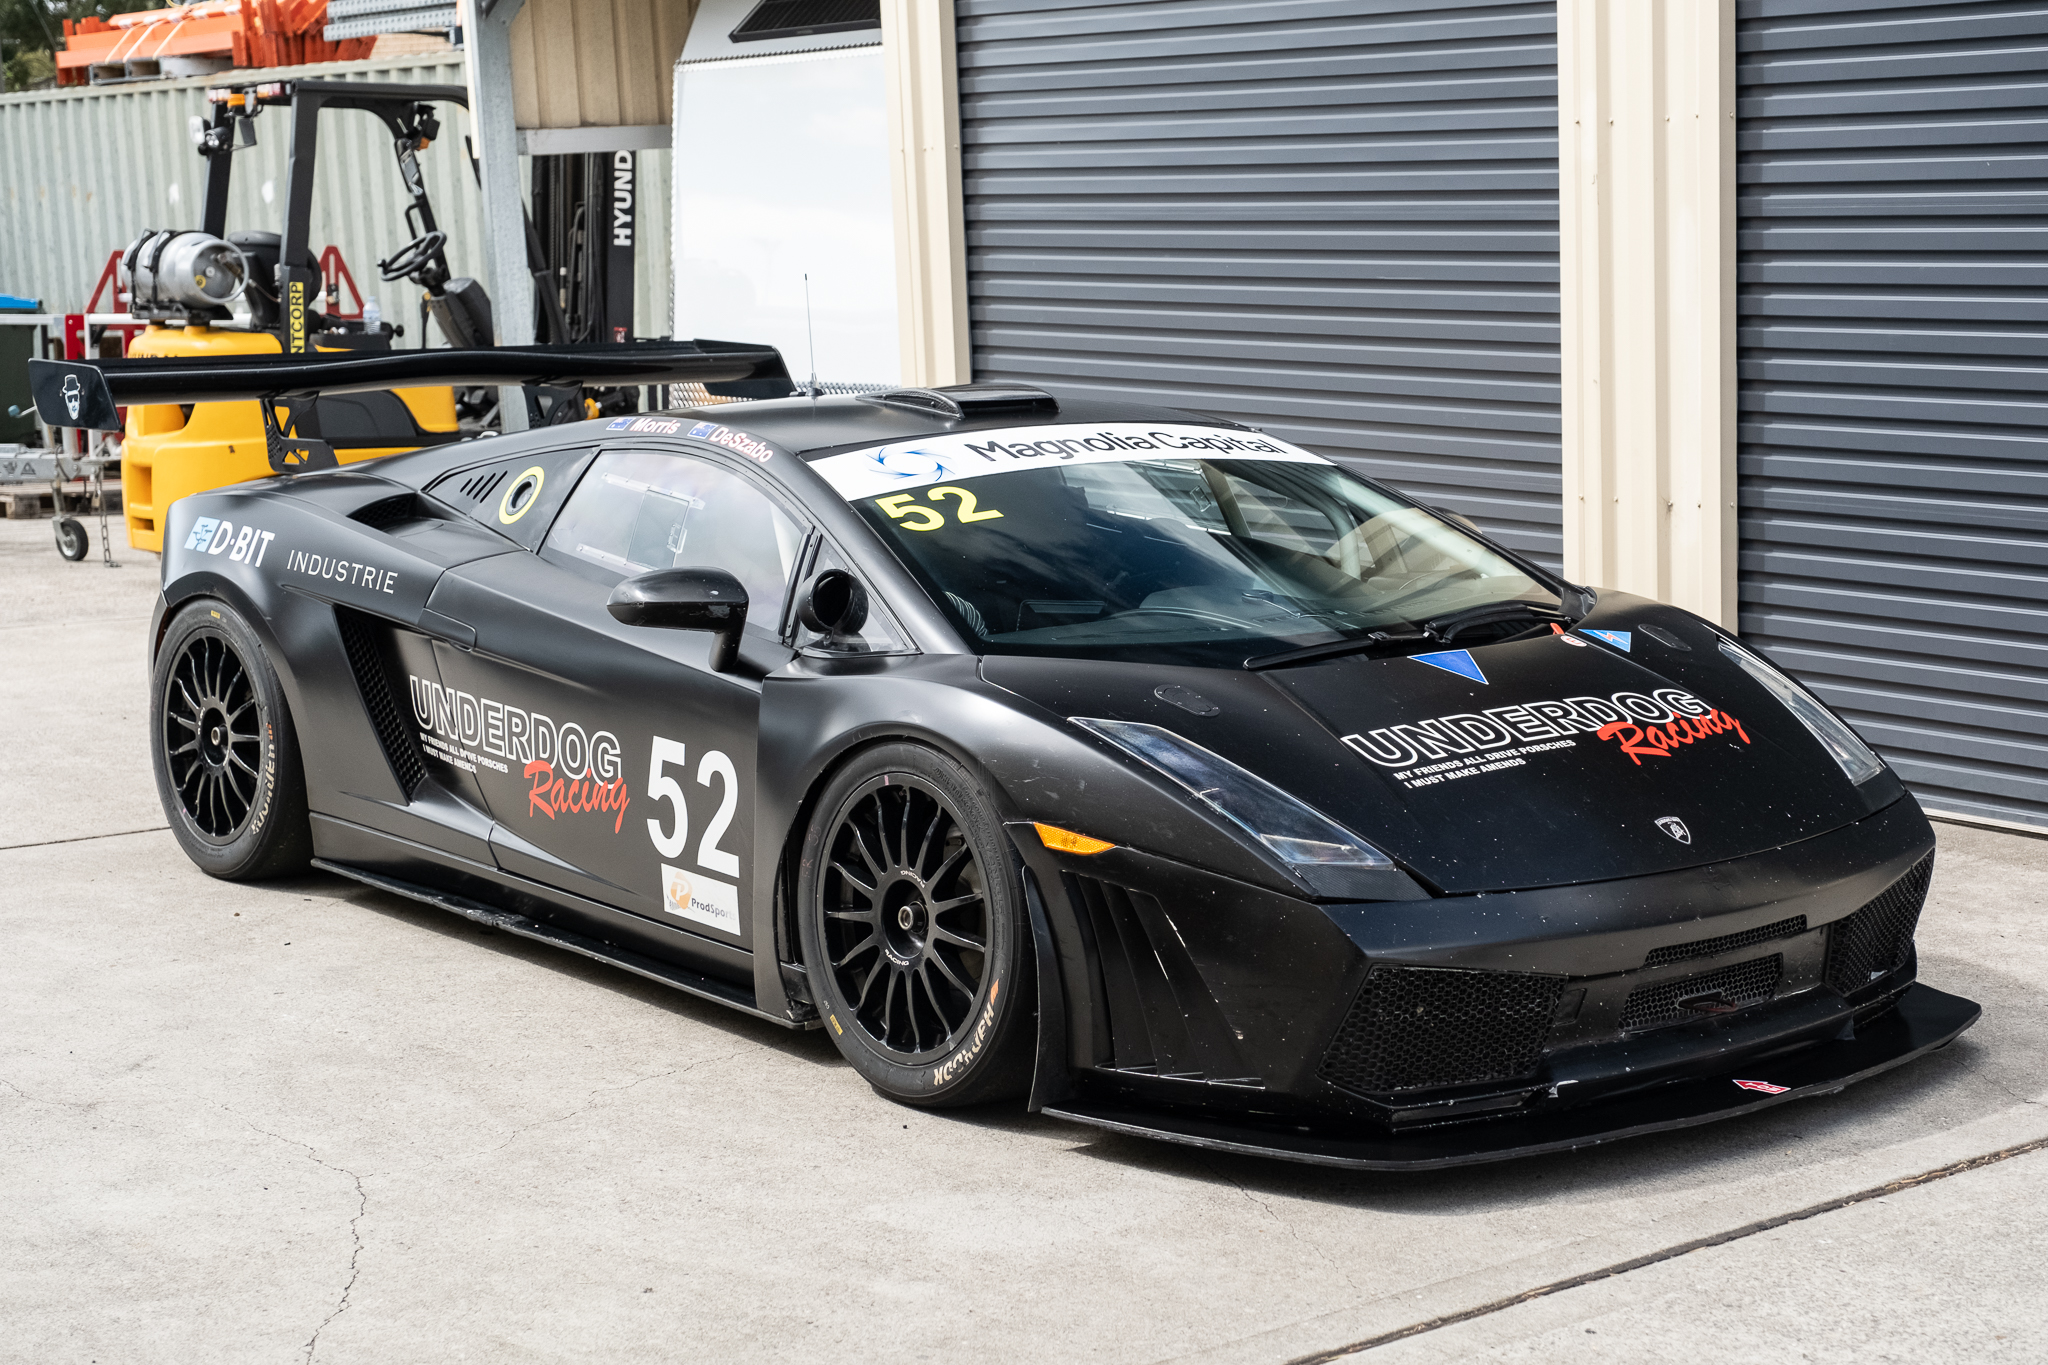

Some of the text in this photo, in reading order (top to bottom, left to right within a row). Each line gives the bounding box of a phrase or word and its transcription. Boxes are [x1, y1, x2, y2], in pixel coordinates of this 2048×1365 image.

[613, 149, 632, 246] HYUND
[629, 418, 681, 434] Morris
[709, 427, 773, 462] DeSzabo
[875, 486, 1004, 531] 52
[287, 549, 398, 594] INDUSTRIE
[410, 674, 622, 789] UNDERDOG
[1340, 688, 1713, 767] UNDERDOG
[1597, 707, 1751, 766] Racing
[477, 755, 509, 774] PORSCHES
[1393, 739, 1577, 781] MY FRIENDS ALL DRIVE PORSCHES
[1403, 758, 1527, 789] I MUST MAKE AMENDS
[524, 759, 631, 834] Racing
[647, 736, 740, 878] 52
[884, 948, 910, 966] RACING
